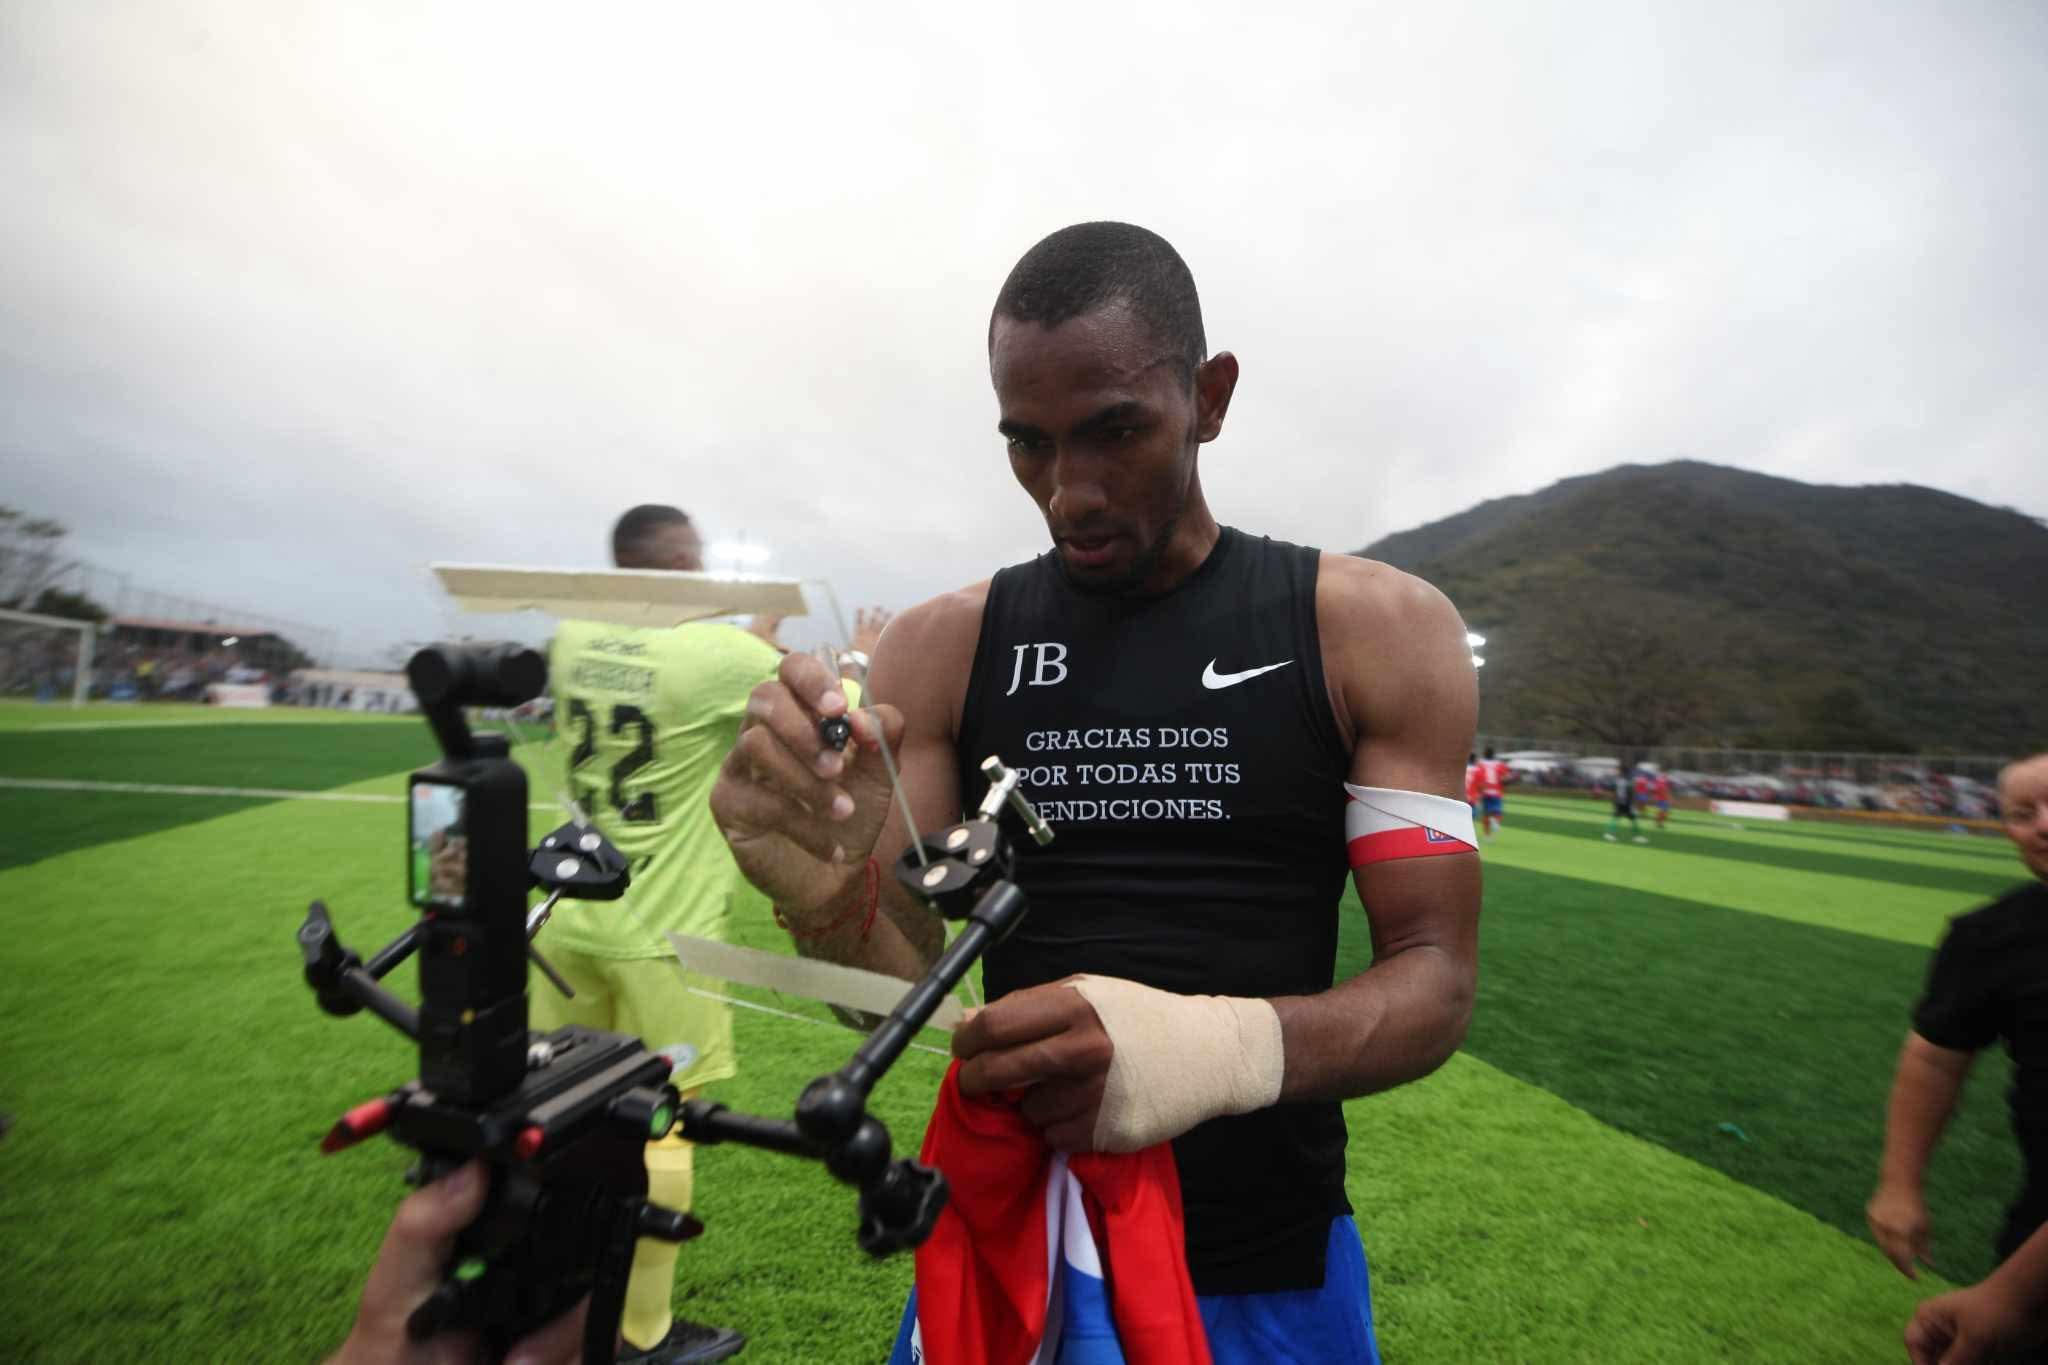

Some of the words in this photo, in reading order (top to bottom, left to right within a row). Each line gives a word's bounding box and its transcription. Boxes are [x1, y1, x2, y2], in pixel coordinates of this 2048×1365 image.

[1006, 642, 1068, 697] JB
[1026, 727, 1151, 751] GRACIAS
[1158, 727, 1229, 748] DIOS
[568, 698, 657, 821] 22
[1016, 765, 1069, 788] POR
[1076, 763, 1177, 785] TODAS
[1185, 763, 1241, 784] TUS
